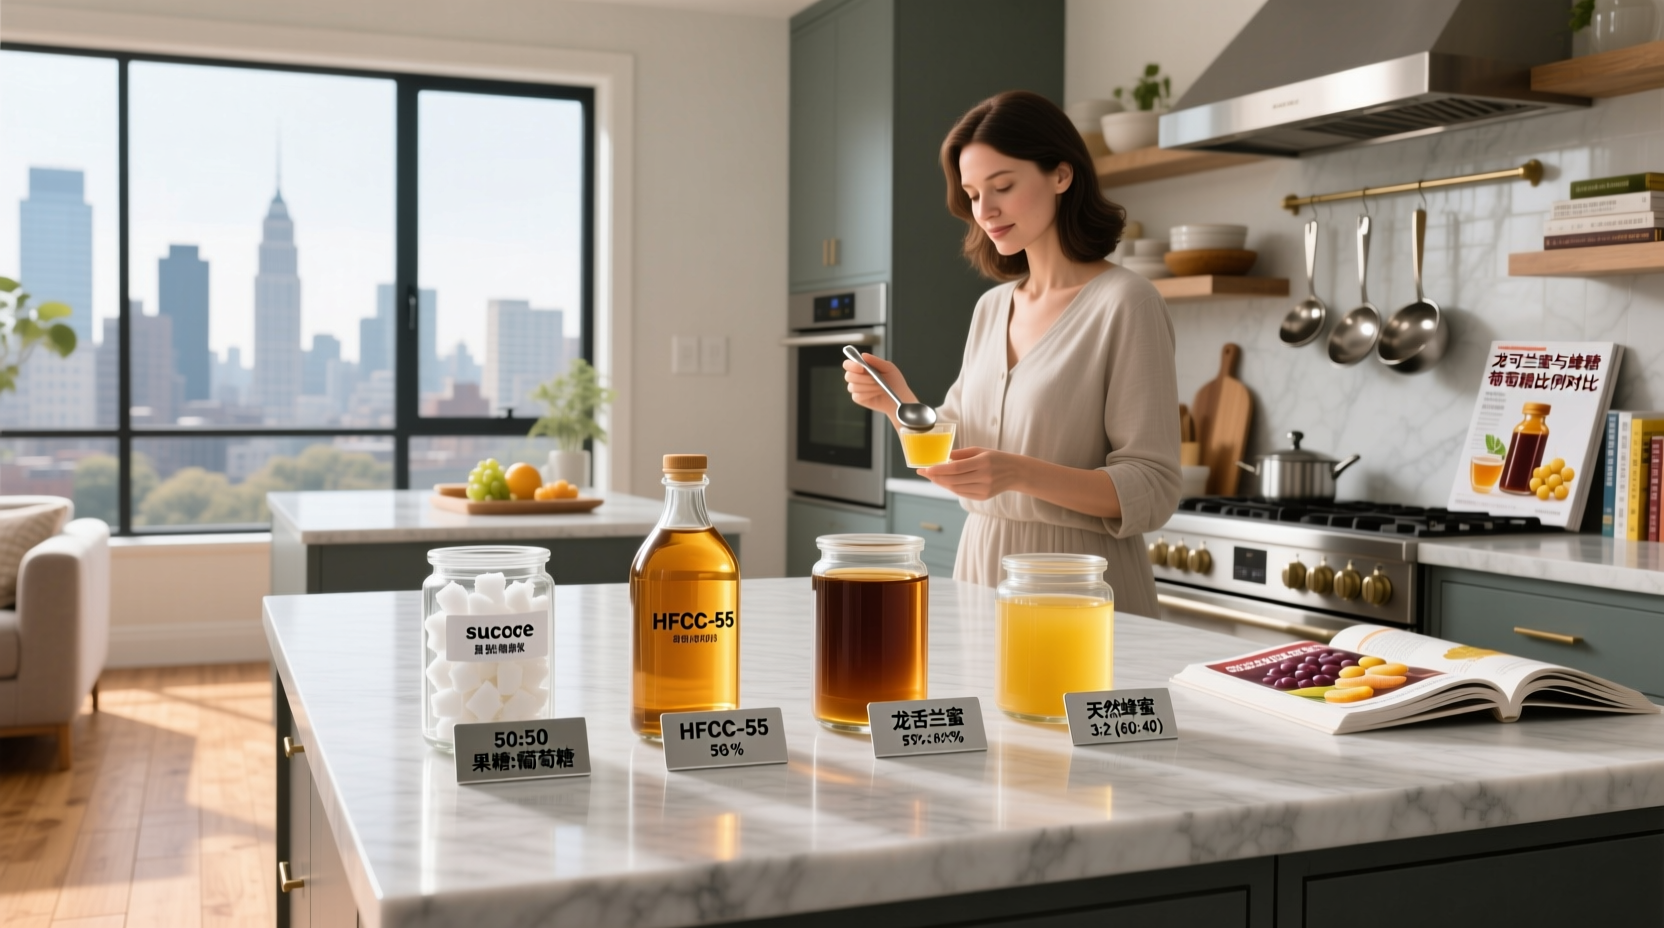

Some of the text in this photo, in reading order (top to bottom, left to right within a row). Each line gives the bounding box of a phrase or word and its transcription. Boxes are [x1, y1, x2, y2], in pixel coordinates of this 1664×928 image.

[653, 611, 734, 630] HFCC-55
[1087, 697, 1155, 719] 天然蜂蜜
[680, 718, 769, 740] HFCC-55
[891, 707, 964, 731] 龙舌兰蜜
[1115, 718, 1163, 738] (60:40)
[494, 728, 548, 749] 50:50
